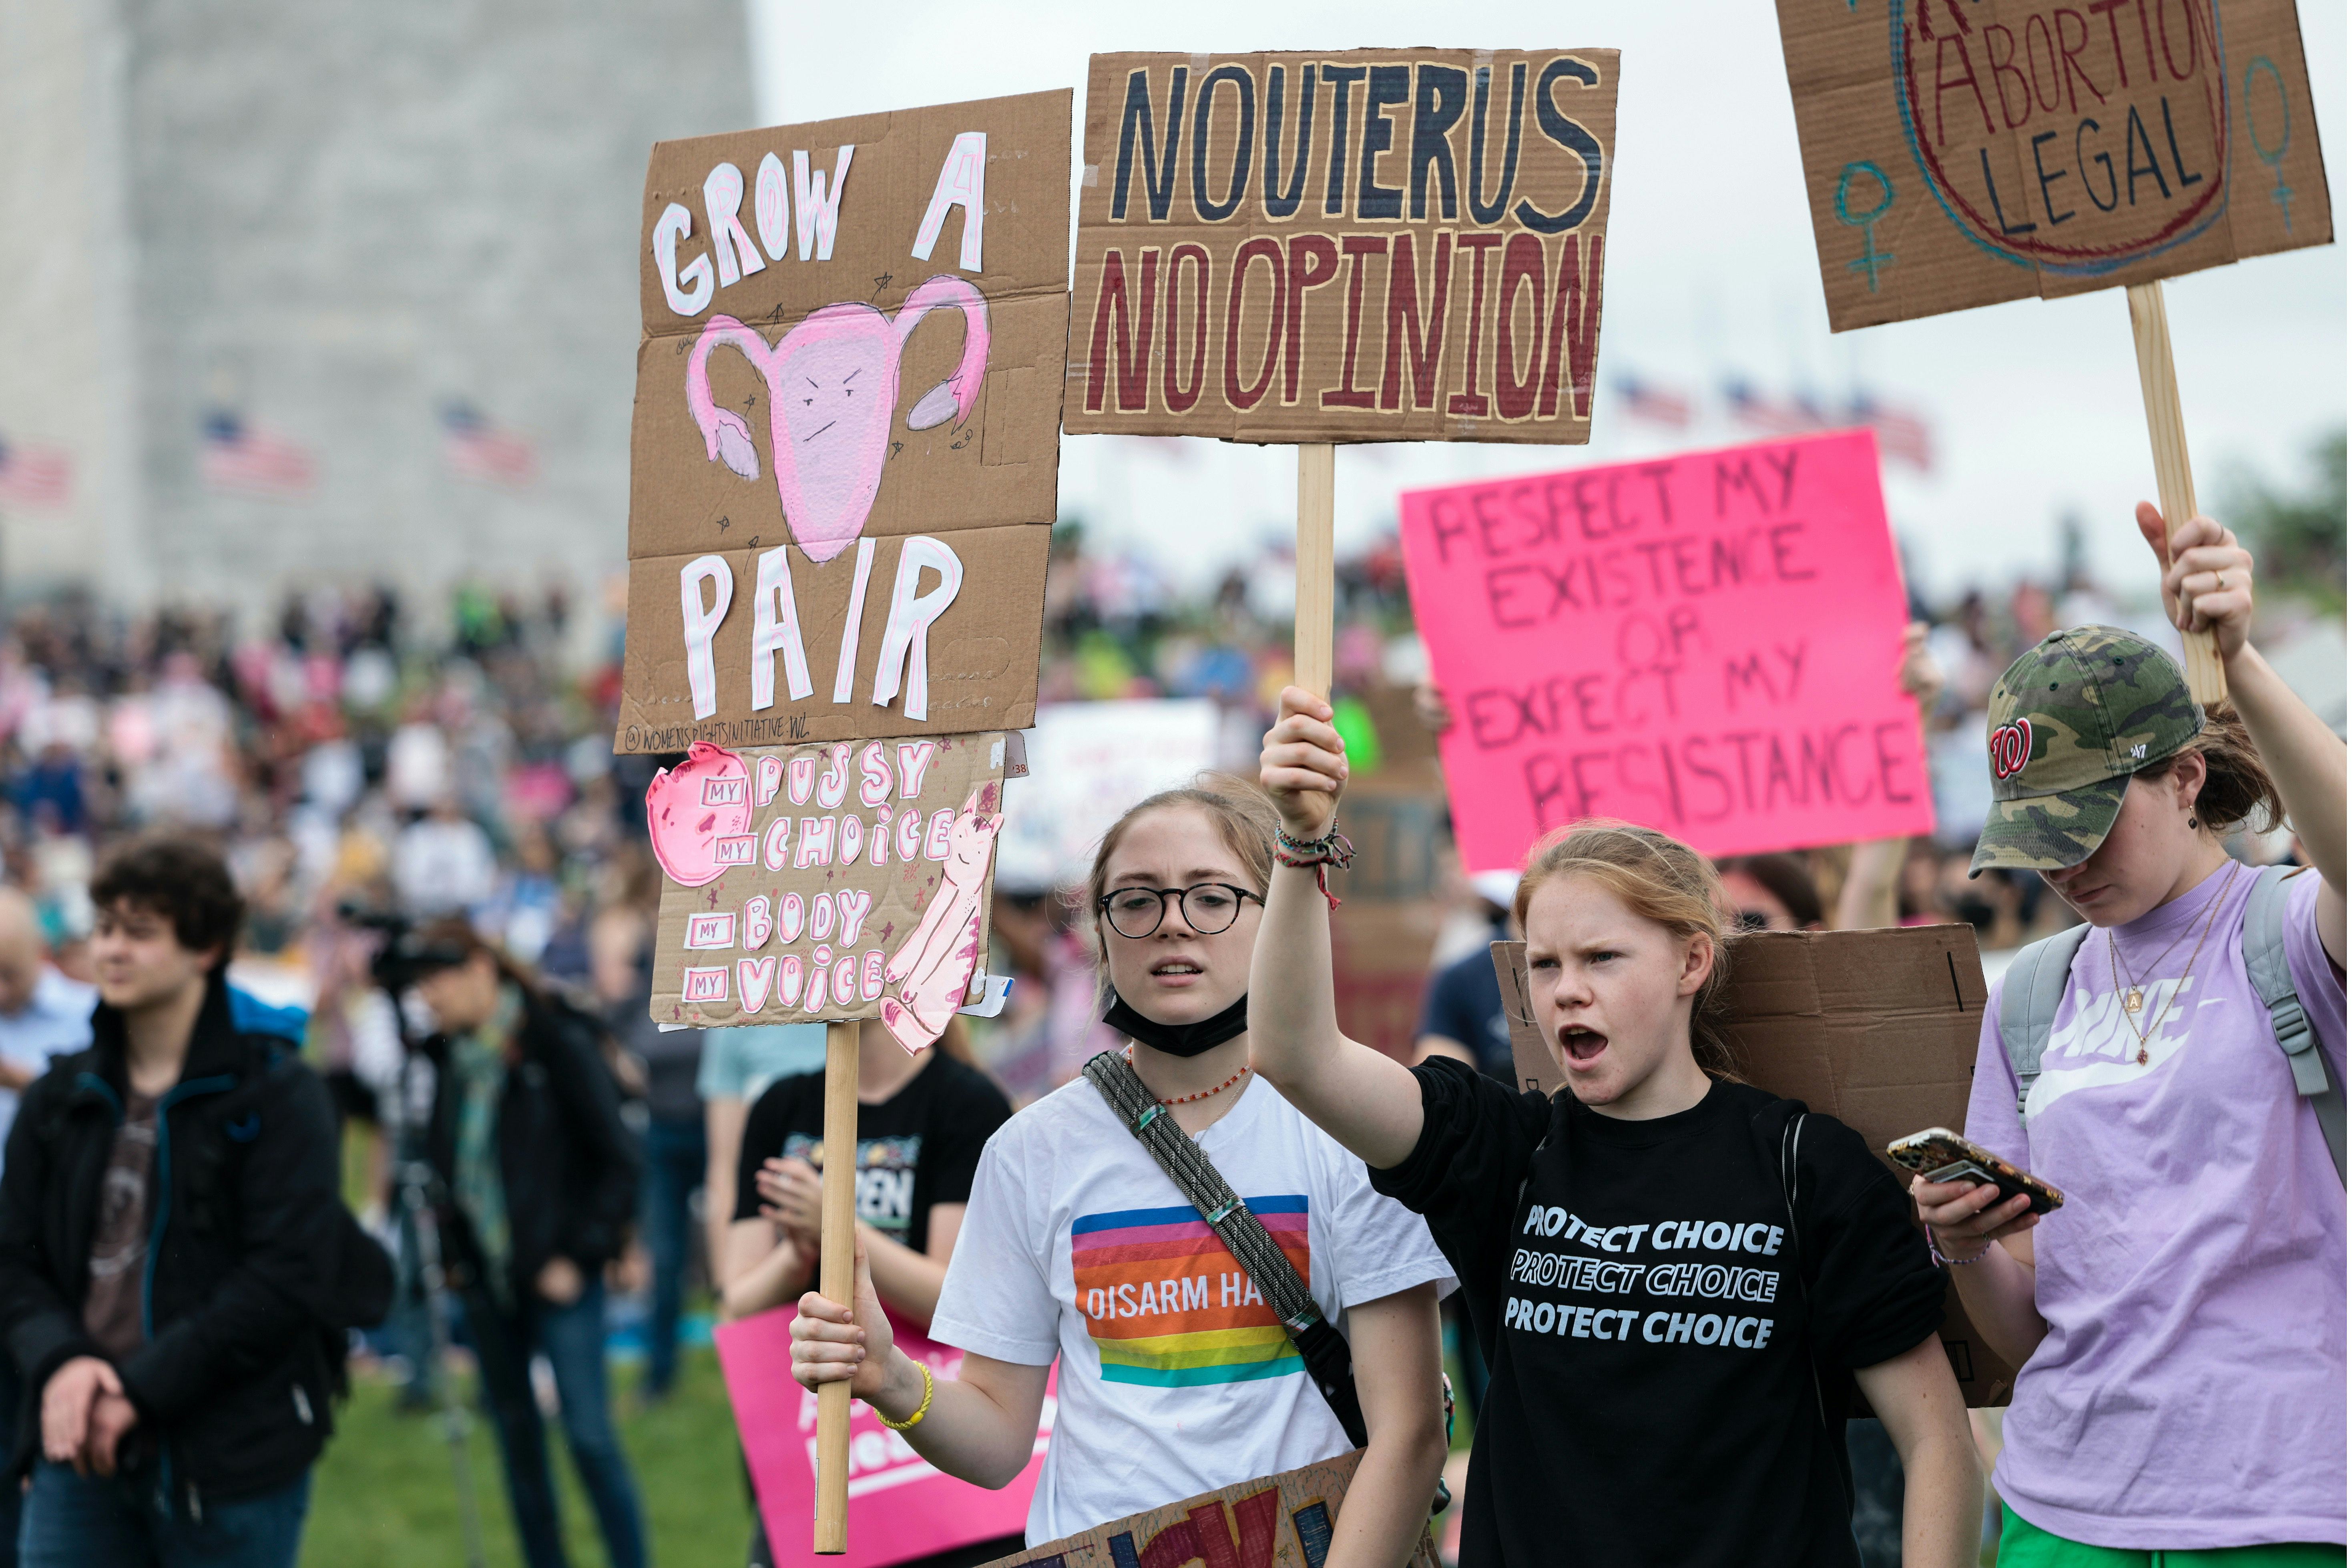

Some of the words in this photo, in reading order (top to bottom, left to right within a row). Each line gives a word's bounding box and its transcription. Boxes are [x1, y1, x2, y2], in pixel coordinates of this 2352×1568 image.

[1980, 96, 2202, 235] LEGAL
[653, 144, 854, 316] GROW
[911, 132, 987, 273] A
[1714, 448, 1798, 516] MY
[1485, 522, 1817, 630] EXISTENCE
[681, 536, 963, 721] PAIR
[1725, 640, 1808, 712] MY
[709, 781, 735, 803] MY
[755, 740, 936, 809] PUSSY
[1990, 717, 2032, 781] W
[720, 843, 745, 860] MY
[699, 921, 718, 939] MY
[743, 888, 872, 951] BODY
[695, 975, 717, 995] MY
[2047, 976, 2195, 1062] NIKE
[1523, 1204, 1649, 1253] PROTECT
[1652, 1220, 1784, 1256] CHOICE
[1087, 1275, 1208, 1321] DISARM
[1510, 1249, 1643, 1294] PROTECT
[1645, 1263, 1780, 1303] CHOICE
[1505, 1297, 1639, 1341] PROTECT
[1643, 1311, 1774, 1349] CHOICE
